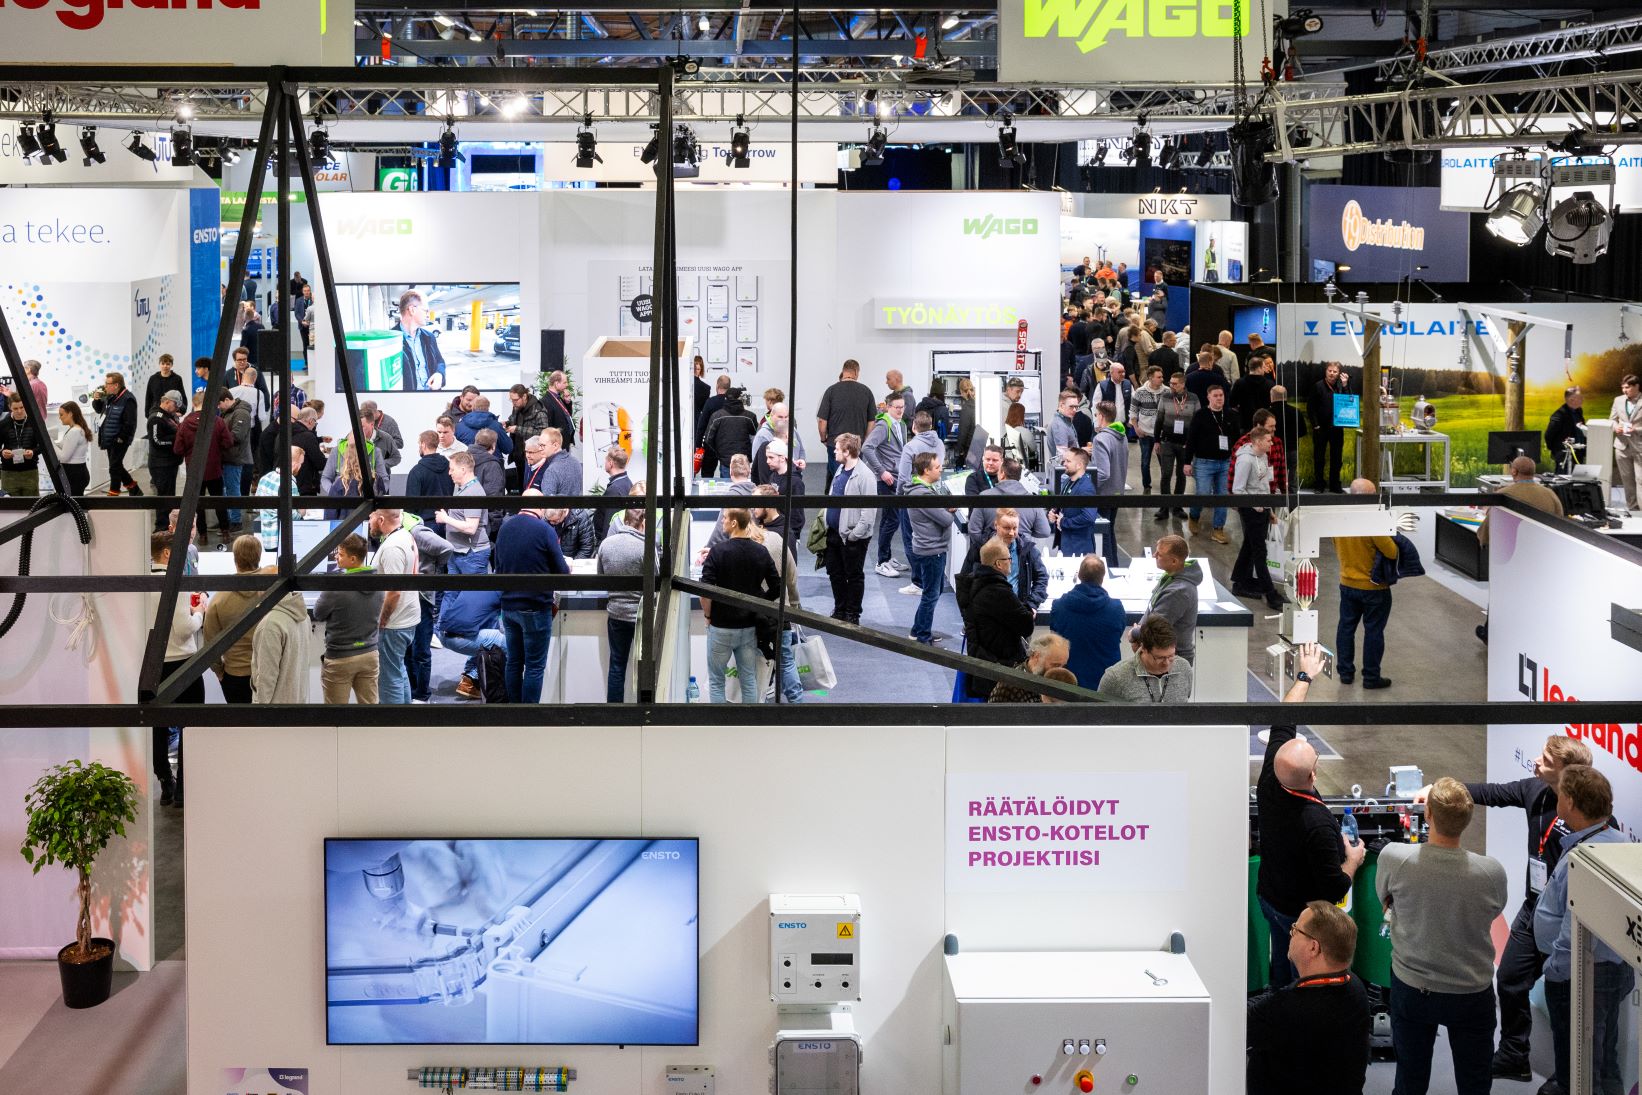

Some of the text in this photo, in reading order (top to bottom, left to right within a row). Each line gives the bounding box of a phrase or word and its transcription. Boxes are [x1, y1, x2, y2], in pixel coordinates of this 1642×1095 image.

[1024, 0, 1250, 53] WAGO
[1139, 199, 1198, 215] NKT
[27, 218, 111, 243] tekee.
[193, 227, 218, 244] ENSTO
[338, 215, 413, 238] WAGO
[963, 213, 1038, 240] WAGO
[882, 303, 1018, 325] TYÖNÄYTÖS
[968, 796, 1120, 816] RÄÄTÄLÖIDYT
[968, 825, 1149, 842] ENSTO-KOTELOT
[641, 851, 680, 860] ENSTO
[968, 850, 1100, 866] PROJEKTIISI
[798, 1042, 831, 1050] ENSTO
